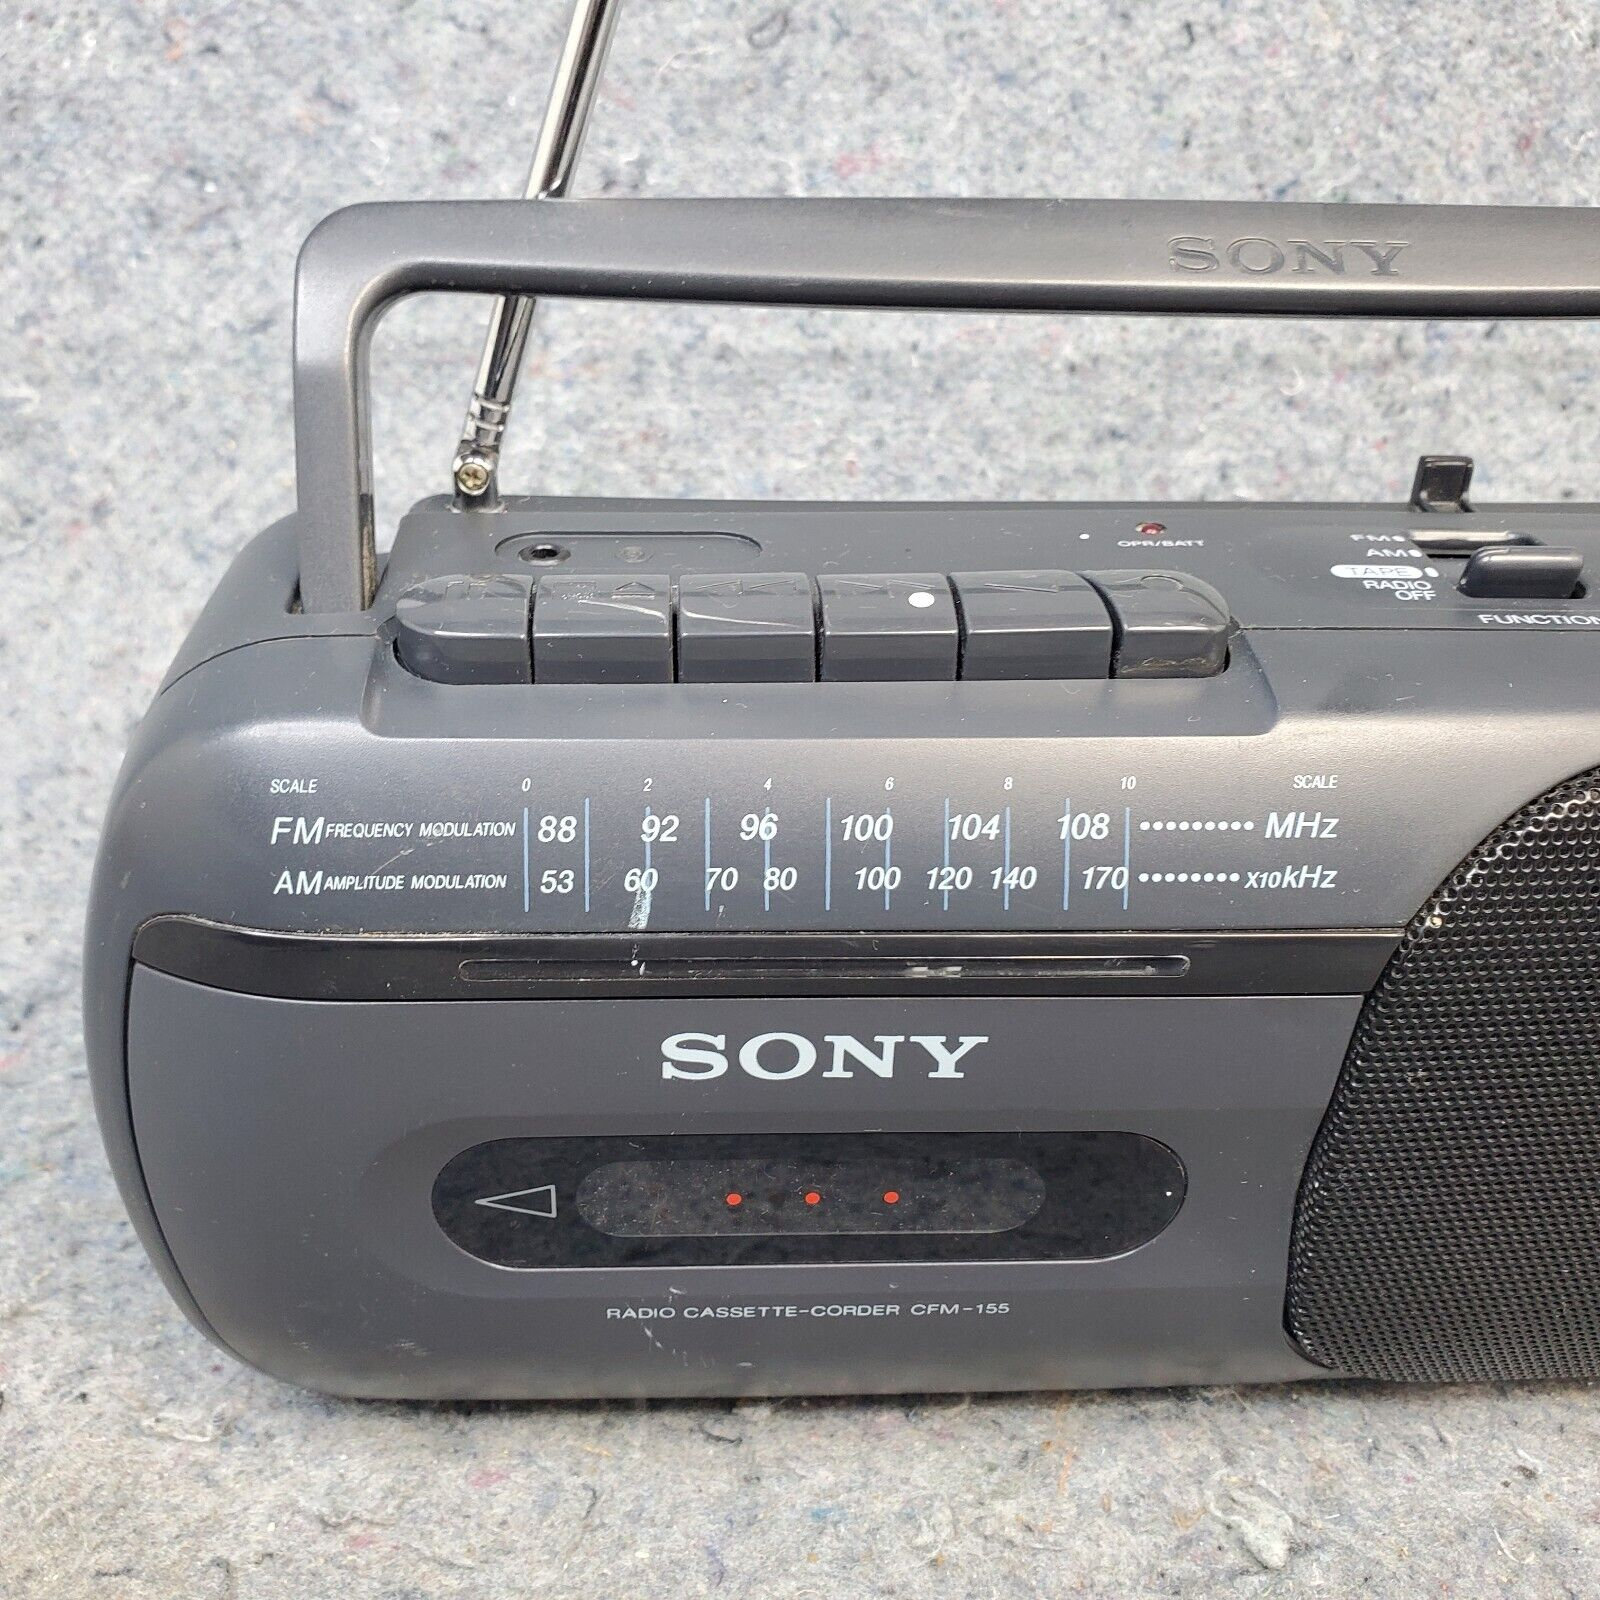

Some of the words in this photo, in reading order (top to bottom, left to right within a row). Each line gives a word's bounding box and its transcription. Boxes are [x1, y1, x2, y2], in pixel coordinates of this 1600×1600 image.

[1167, 235, 1410, 276] SONY
[1117, 539, 1204, 548] OPR/BATT
[1350, 534, 1391, 542] FM
[1367, 548, 1407, 558] AM
[1346, 567, 1412, 577] TAPE
[1363, 579, 1431, 591] RADIO
[1395, 590, 1436, 601] OFF
[270, 778, 318, 794] SCALE
[521, 777, 531, 793] 0
[643, 778, 653, 793] 2
[763, 777, 773, 791] 4
[884, 776, 895, 791] 6
[1003, 776, 1014, 791] 8
[1120, 776, 1137, 790] 10
[1293, 774, 1338, 790] SCALE
[270, 816, 325, 845] FM
[325, 822, 413, 839] FREQUENCY
[418, 821, 517, 838] MODULATION
[537, 815, 578, 843] 88
[640, 815, 681, 843] 92
[739, 813, 779, 841] 96
[840, 814, 894, 841] 100
[948, 813, 1001, 840] 104
[1056, 812, 1111, 840] 108
[1264, 811, 1340, 839] MHz
[272, 870, 324, 895] AM
[323, 874, 406, 891] AMPLITUDE
[410, 873, 507, 889] MODULATION
[539, 869, 575, 894] 53
[623, 867, 660, 893] 60
[705, 867, 739, 891] 70
[762, 866, 798, 891] 80
[854, 866, 901, 890] 100
[926, 866, 973, 890] 120
[990, 866, 1038, 890] 140
[1081, 866, 1130, 890] 170
[661, 1032, 990, 1081] SONY
[606, 1306, 676, 1320] RADIO
[683, 1304, 901, 1319] CASSETTE-CORDER
[910, 1302, 1011, 1316] CFM-155
